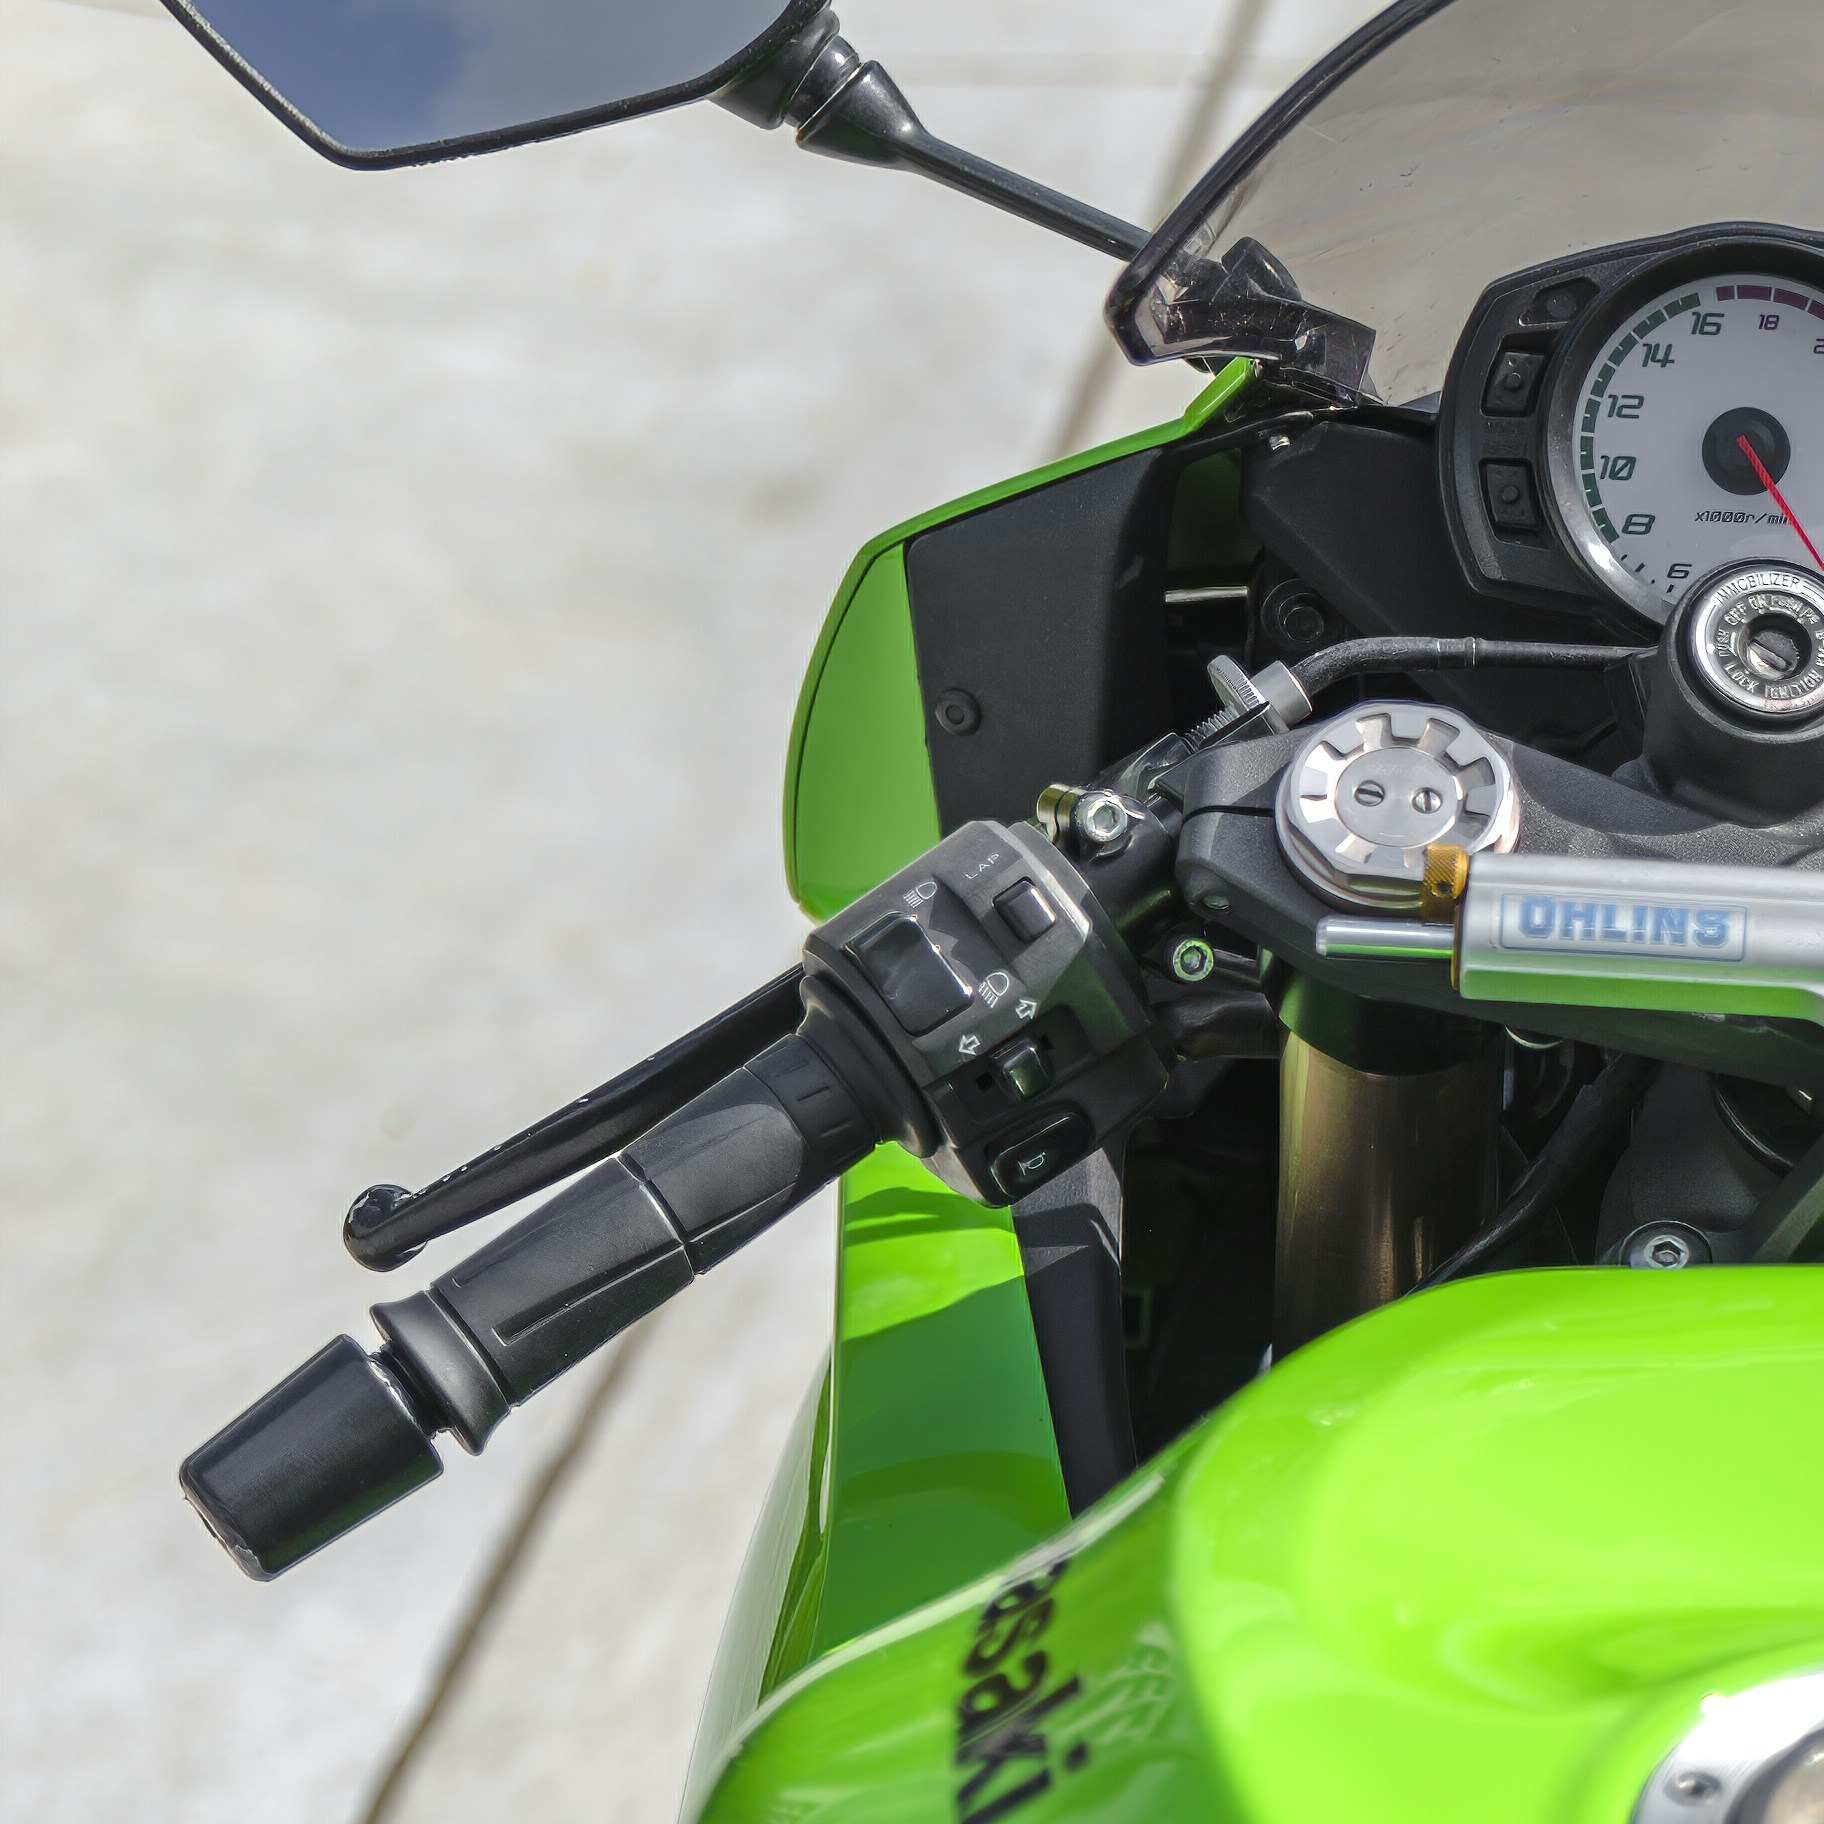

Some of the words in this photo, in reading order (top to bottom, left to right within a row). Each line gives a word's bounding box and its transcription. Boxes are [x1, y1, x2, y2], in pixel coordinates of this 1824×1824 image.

[1691, 312, 1725, 336] 16
[1758, 314, 1780, 331] 18
[1642, 343, 1676, 368] 14
[1607, 394, 1645, 419] 12
[1600, 455, 1637, 481] 10
[1621, 513, 1656, 536] 8
[1666, 562, 1693, 580] 6
[1715, 572, 1801, 605] IMMOBILIZER
[1724, 662, 1760, 693] LOCK
[1764, 669, 1824, 700] IGNITION
[963, 853, 1000, 880] LAP
